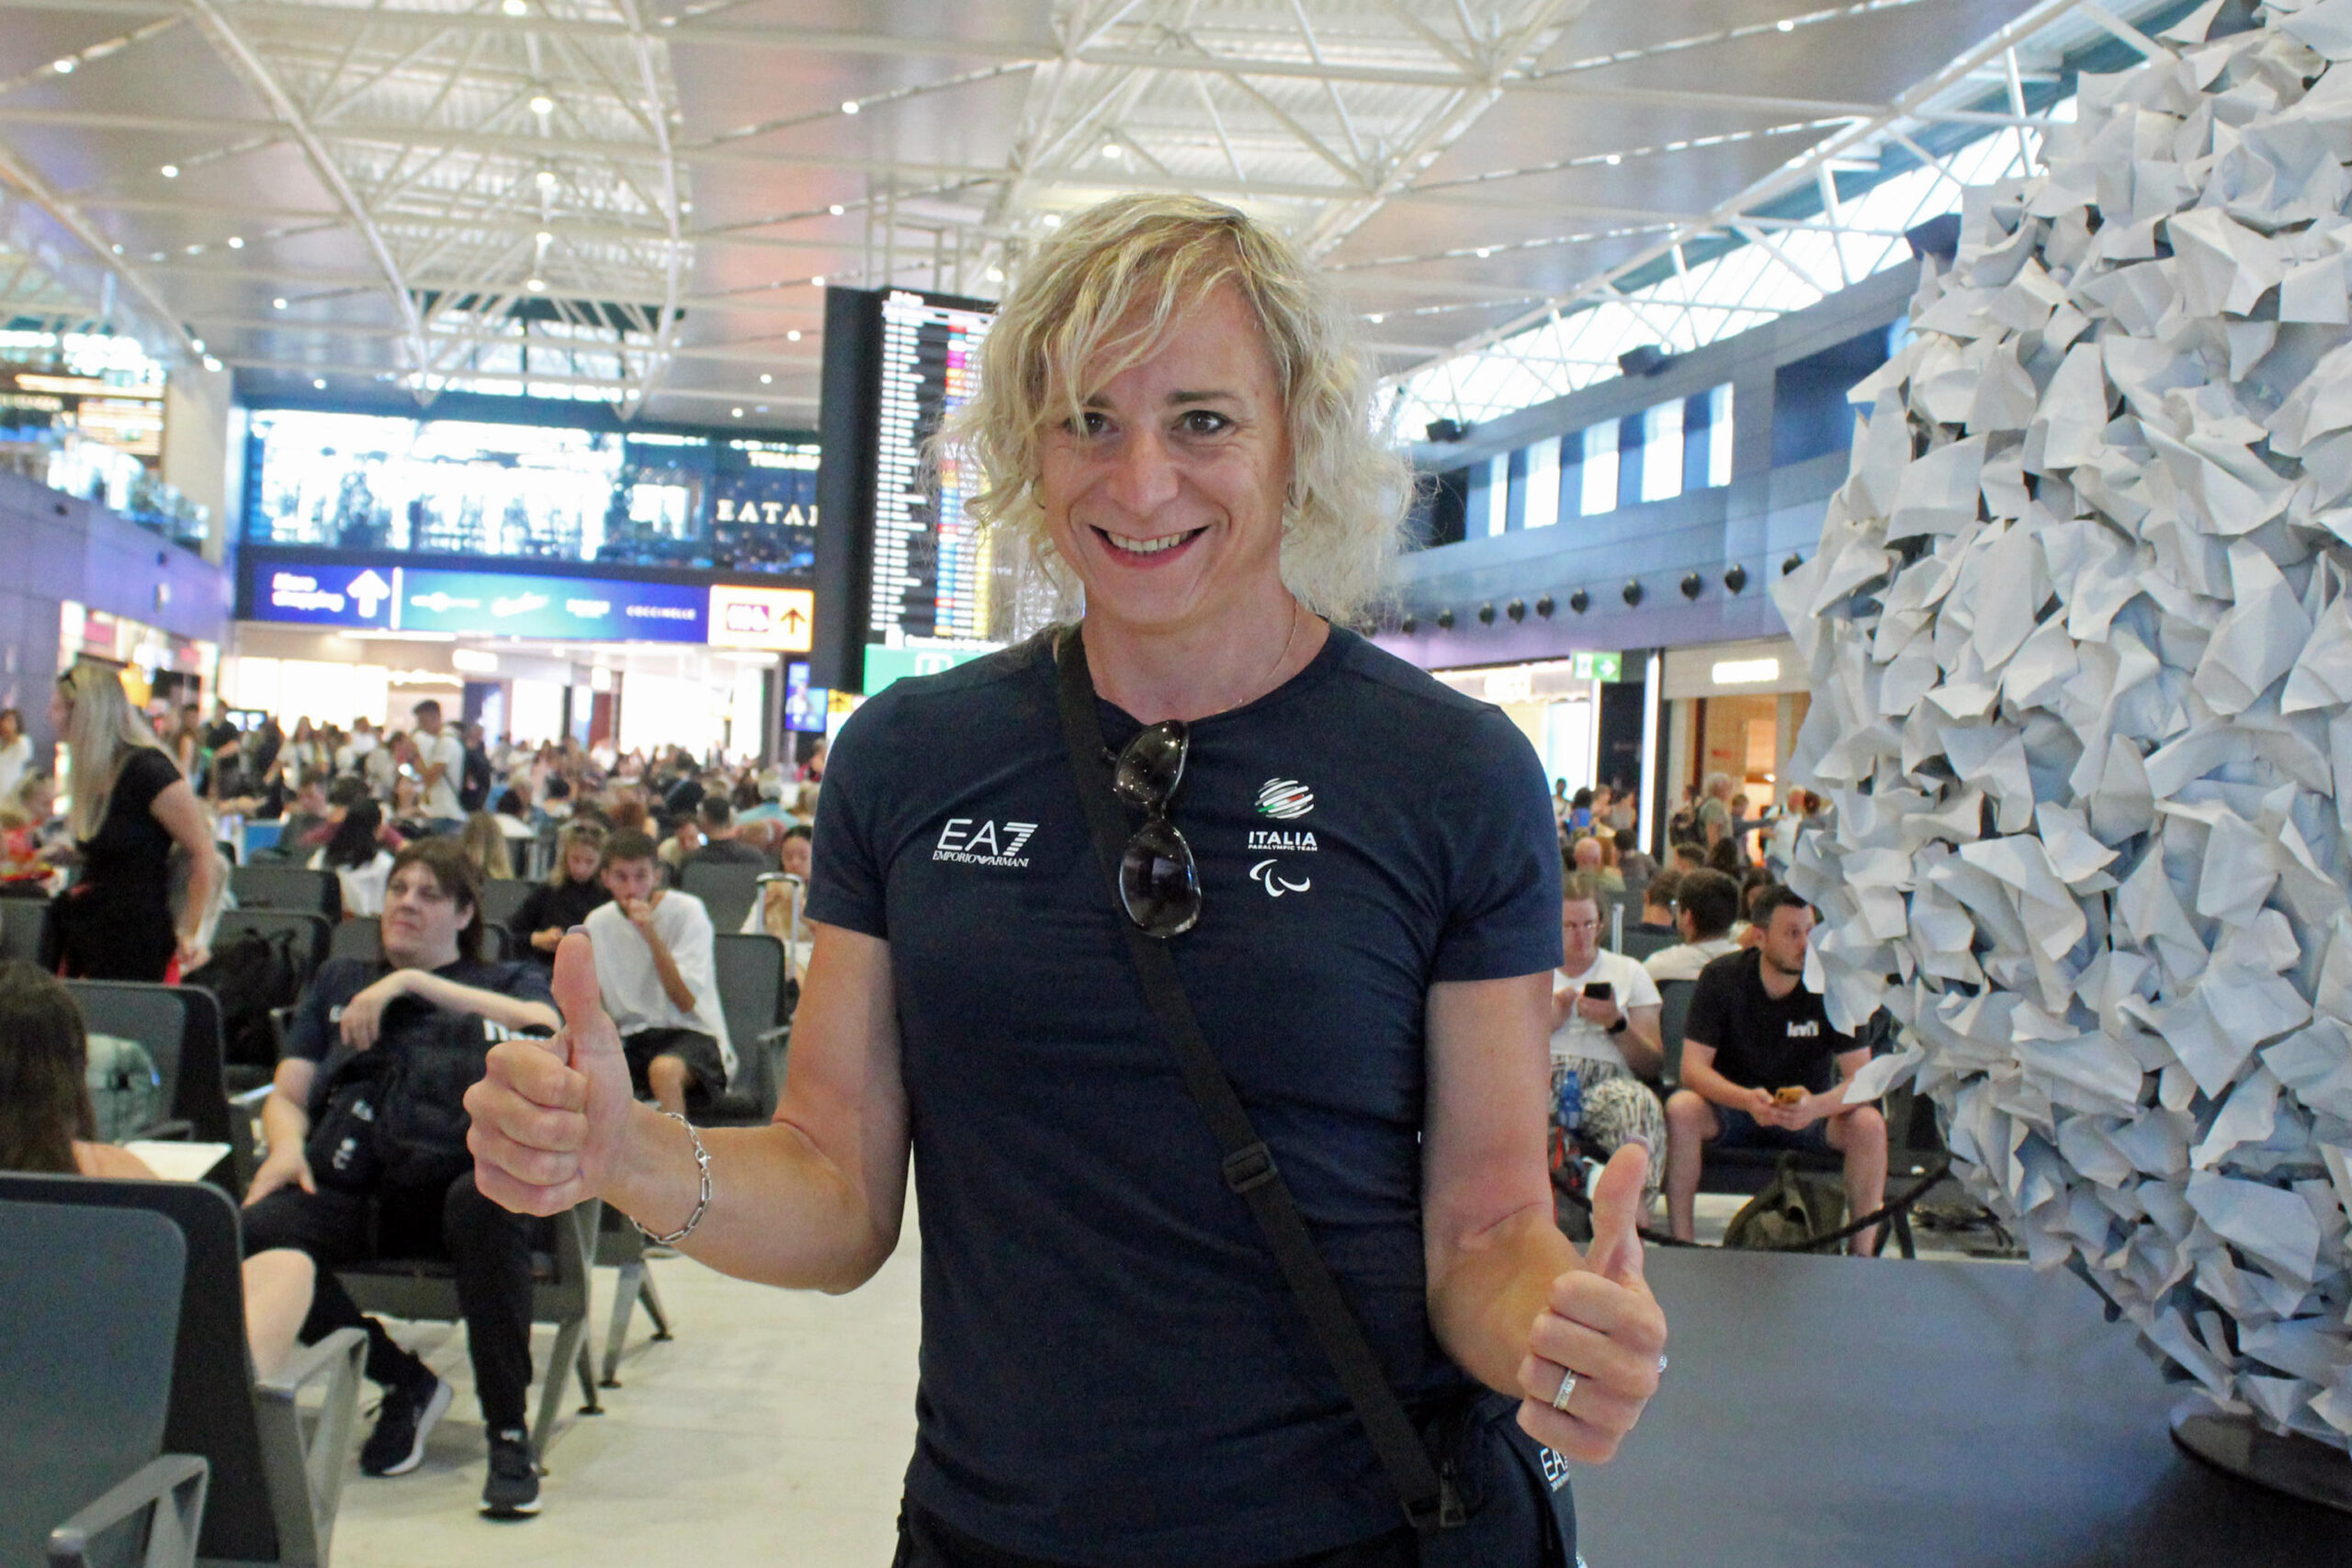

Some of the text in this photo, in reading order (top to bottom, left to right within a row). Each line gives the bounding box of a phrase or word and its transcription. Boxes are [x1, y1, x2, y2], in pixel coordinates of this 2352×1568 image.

[936, 818, 1039, 857] EA7
[1248, 830, 1317, 847] ITALIA
[1248, 843, 1296, 852] PARALYMPIC
[932, 849, 1030, 868] EMPORIO ARMANI
